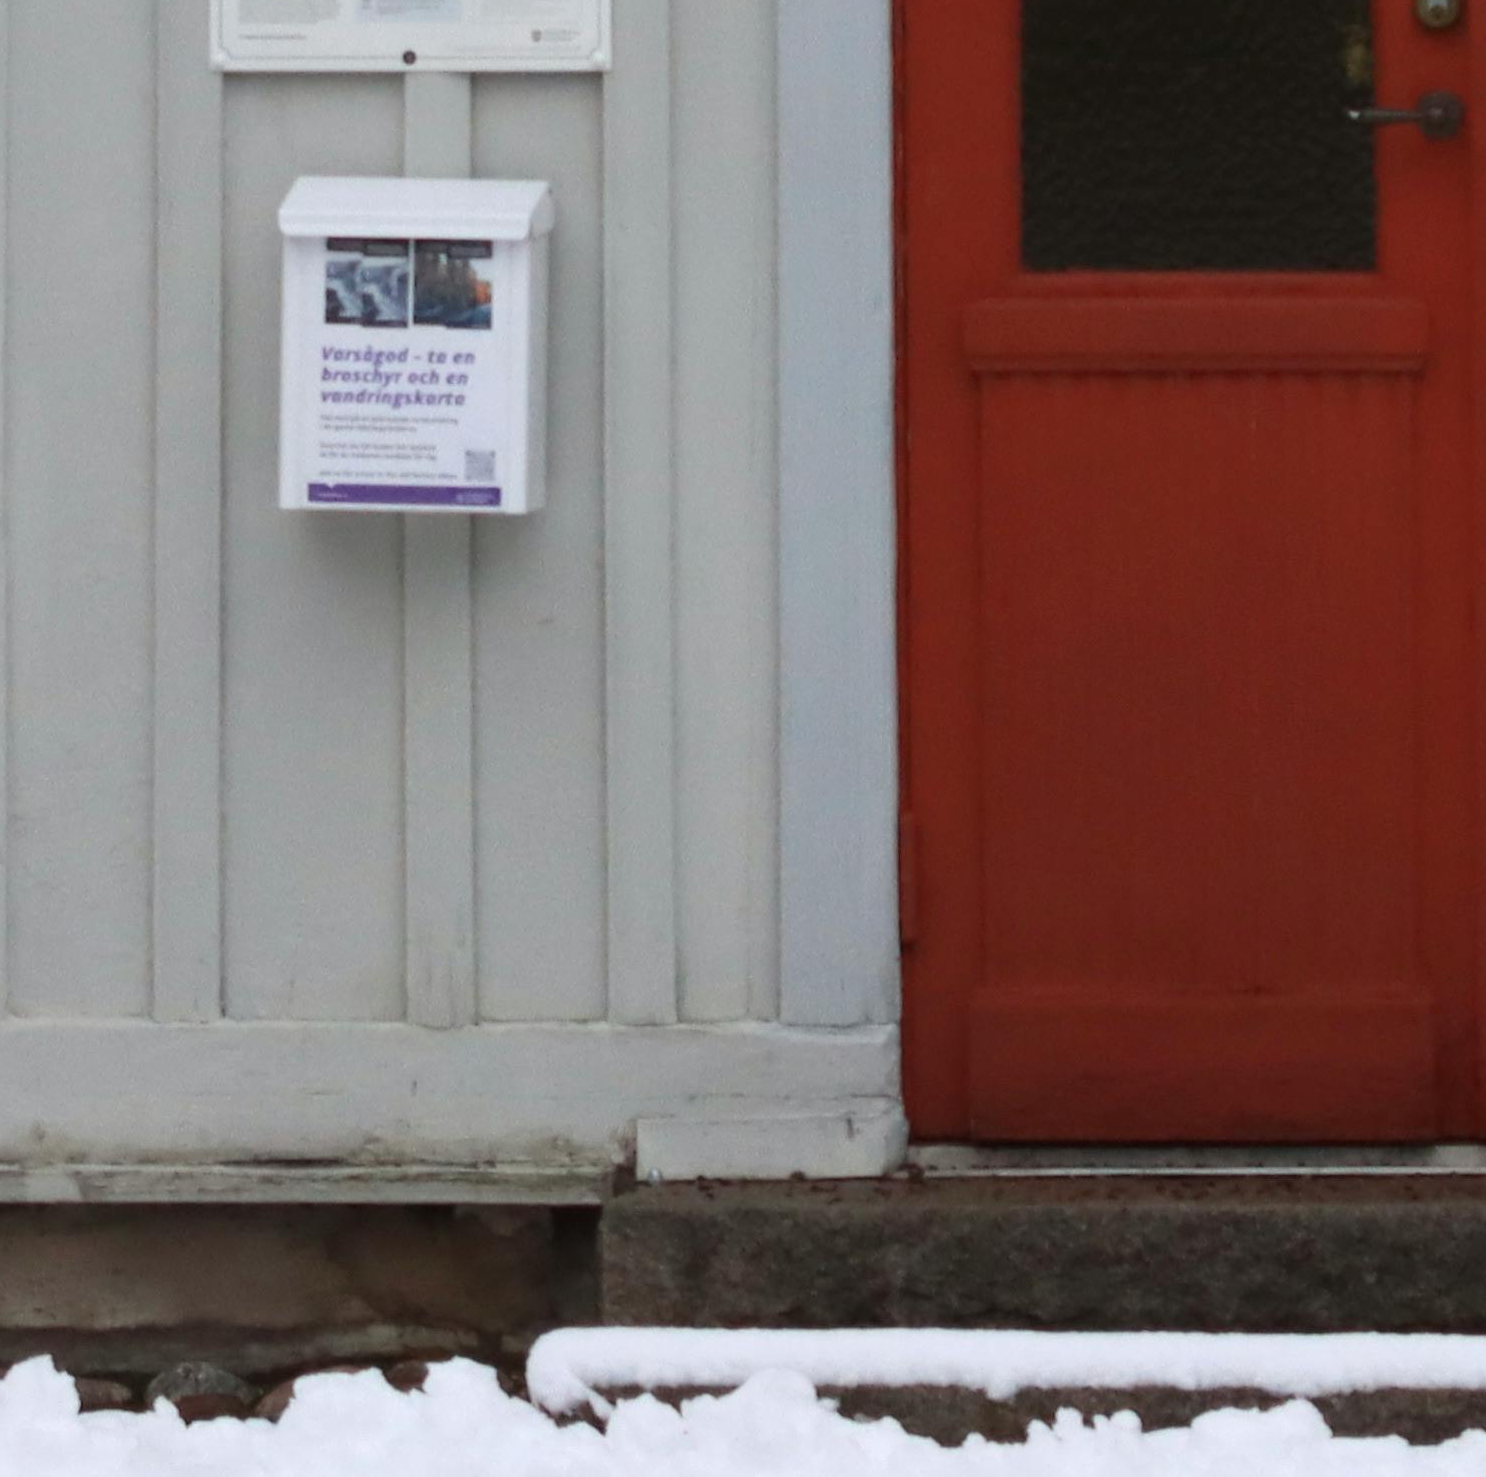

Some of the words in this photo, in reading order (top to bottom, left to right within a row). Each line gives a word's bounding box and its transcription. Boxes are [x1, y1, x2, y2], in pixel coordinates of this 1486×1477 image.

[322, 345, 409, 367] Varsågod
[428, 350, 448, 365] ta
[452, 351, 476, 365] en
[321, 367, 402, 387] broschyr
[407, 369, 440, 385] och
[446, 372, 469, 385] en
[321, 389, 466, 409] vandringskarta
